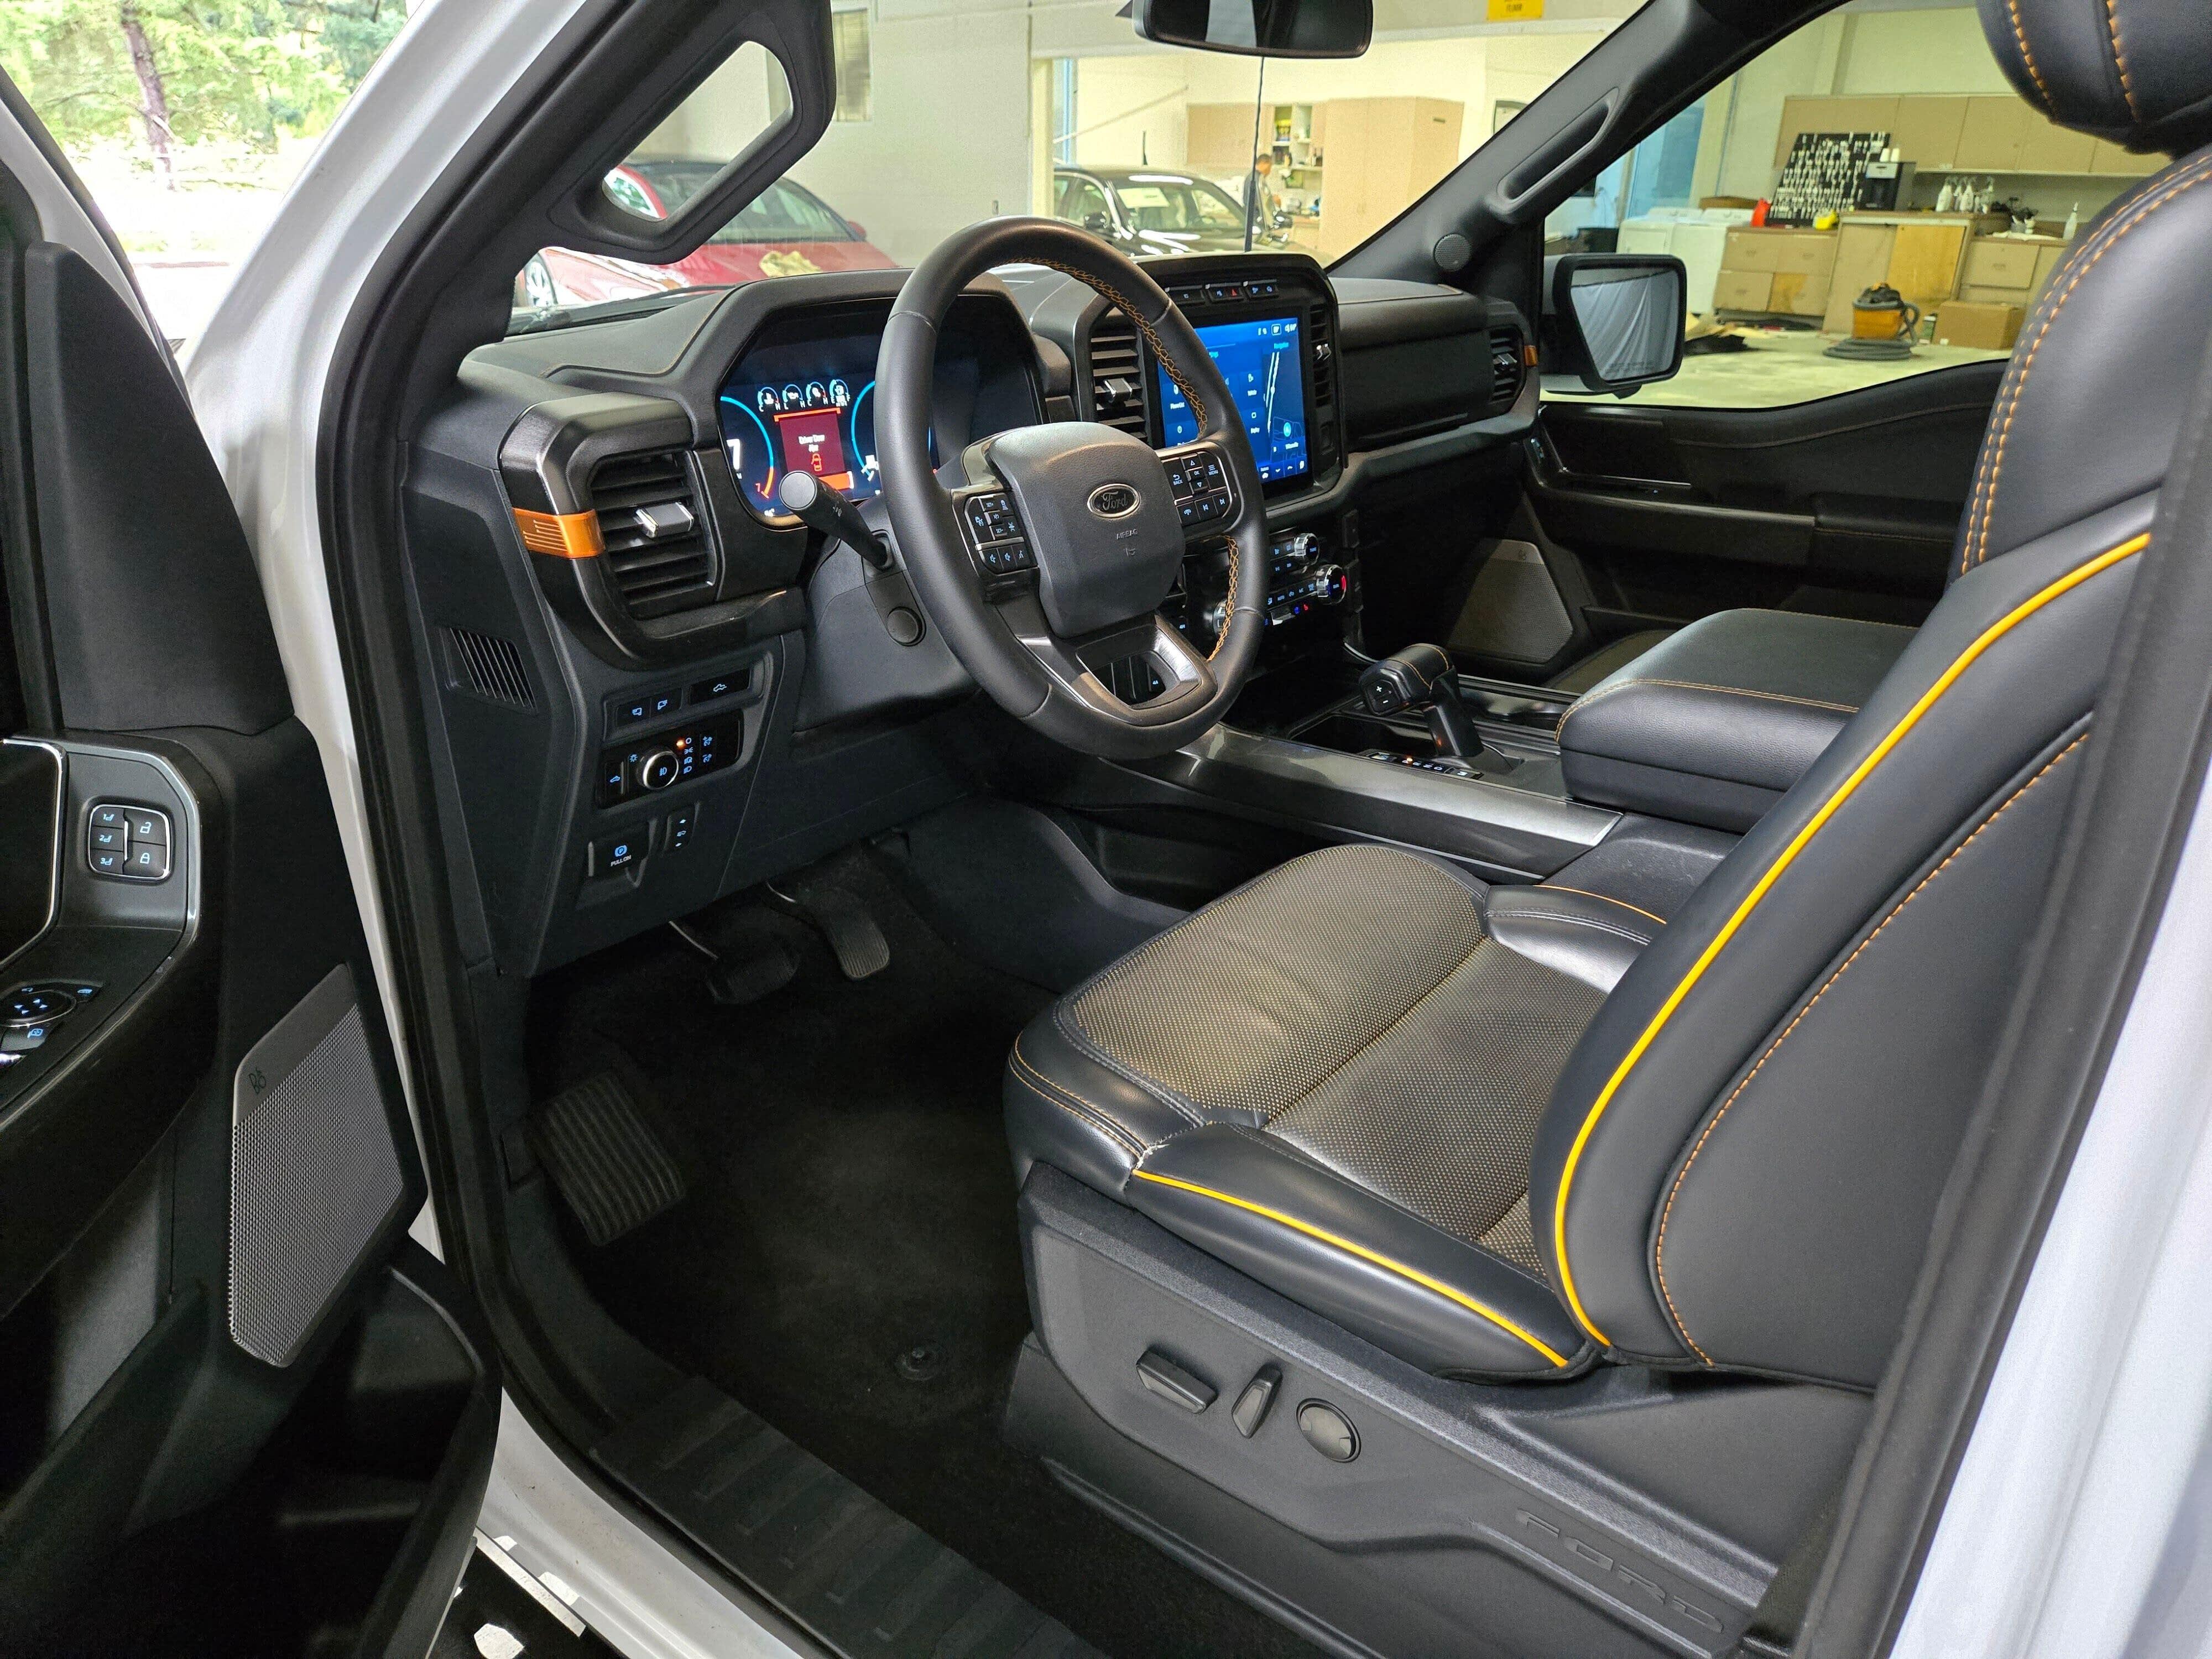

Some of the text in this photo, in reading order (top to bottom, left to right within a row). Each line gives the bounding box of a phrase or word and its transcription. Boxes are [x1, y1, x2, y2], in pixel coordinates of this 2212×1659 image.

[1102, 491, 1128, 510] Ford
[1117, 529, 1138, 540] AIRBAG
[611, 858, 623, 867] PULL
[1515, 1507, 1724, 1633] FORD
